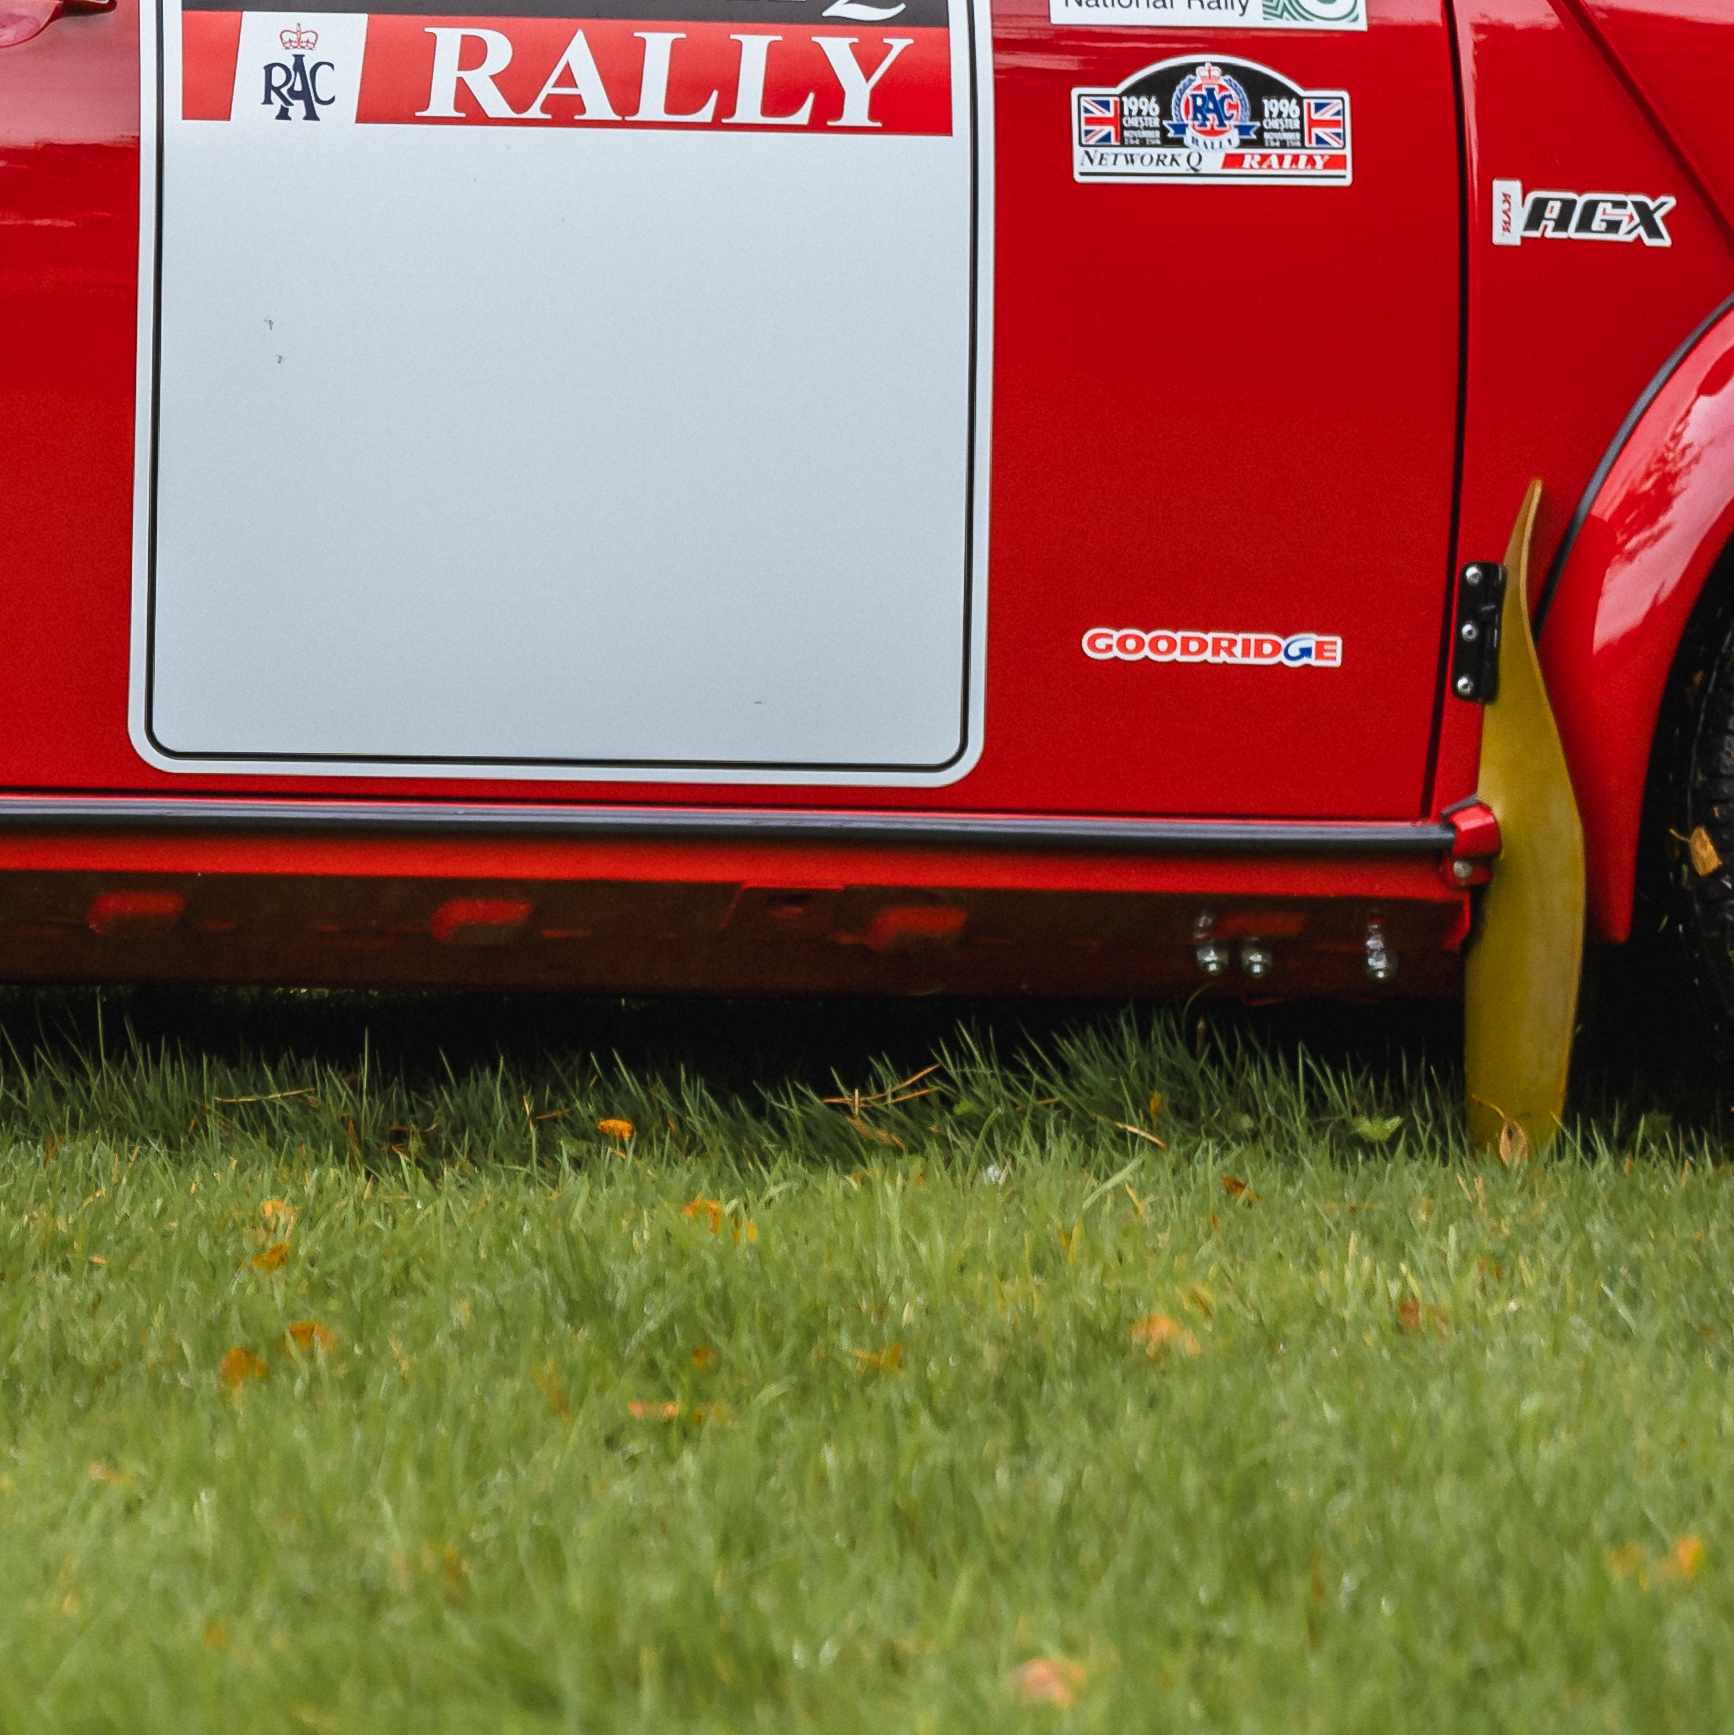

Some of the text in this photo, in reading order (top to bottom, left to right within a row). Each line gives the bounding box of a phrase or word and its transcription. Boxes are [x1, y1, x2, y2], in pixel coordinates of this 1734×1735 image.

[262, 54, 337, 121] RAC
[415, 26, 915, 128] RALLY
[1122, 95, 1160, 117] 1996
[1189, 86, 1235, 128] RAC
[1262, 97, 1301, 119] 1996
[1240, 154, 1330, 170] RALLY
[1523, 197, 1669, 241] AGX
[1086, 632, 1337, 663] GOODRIDGE
